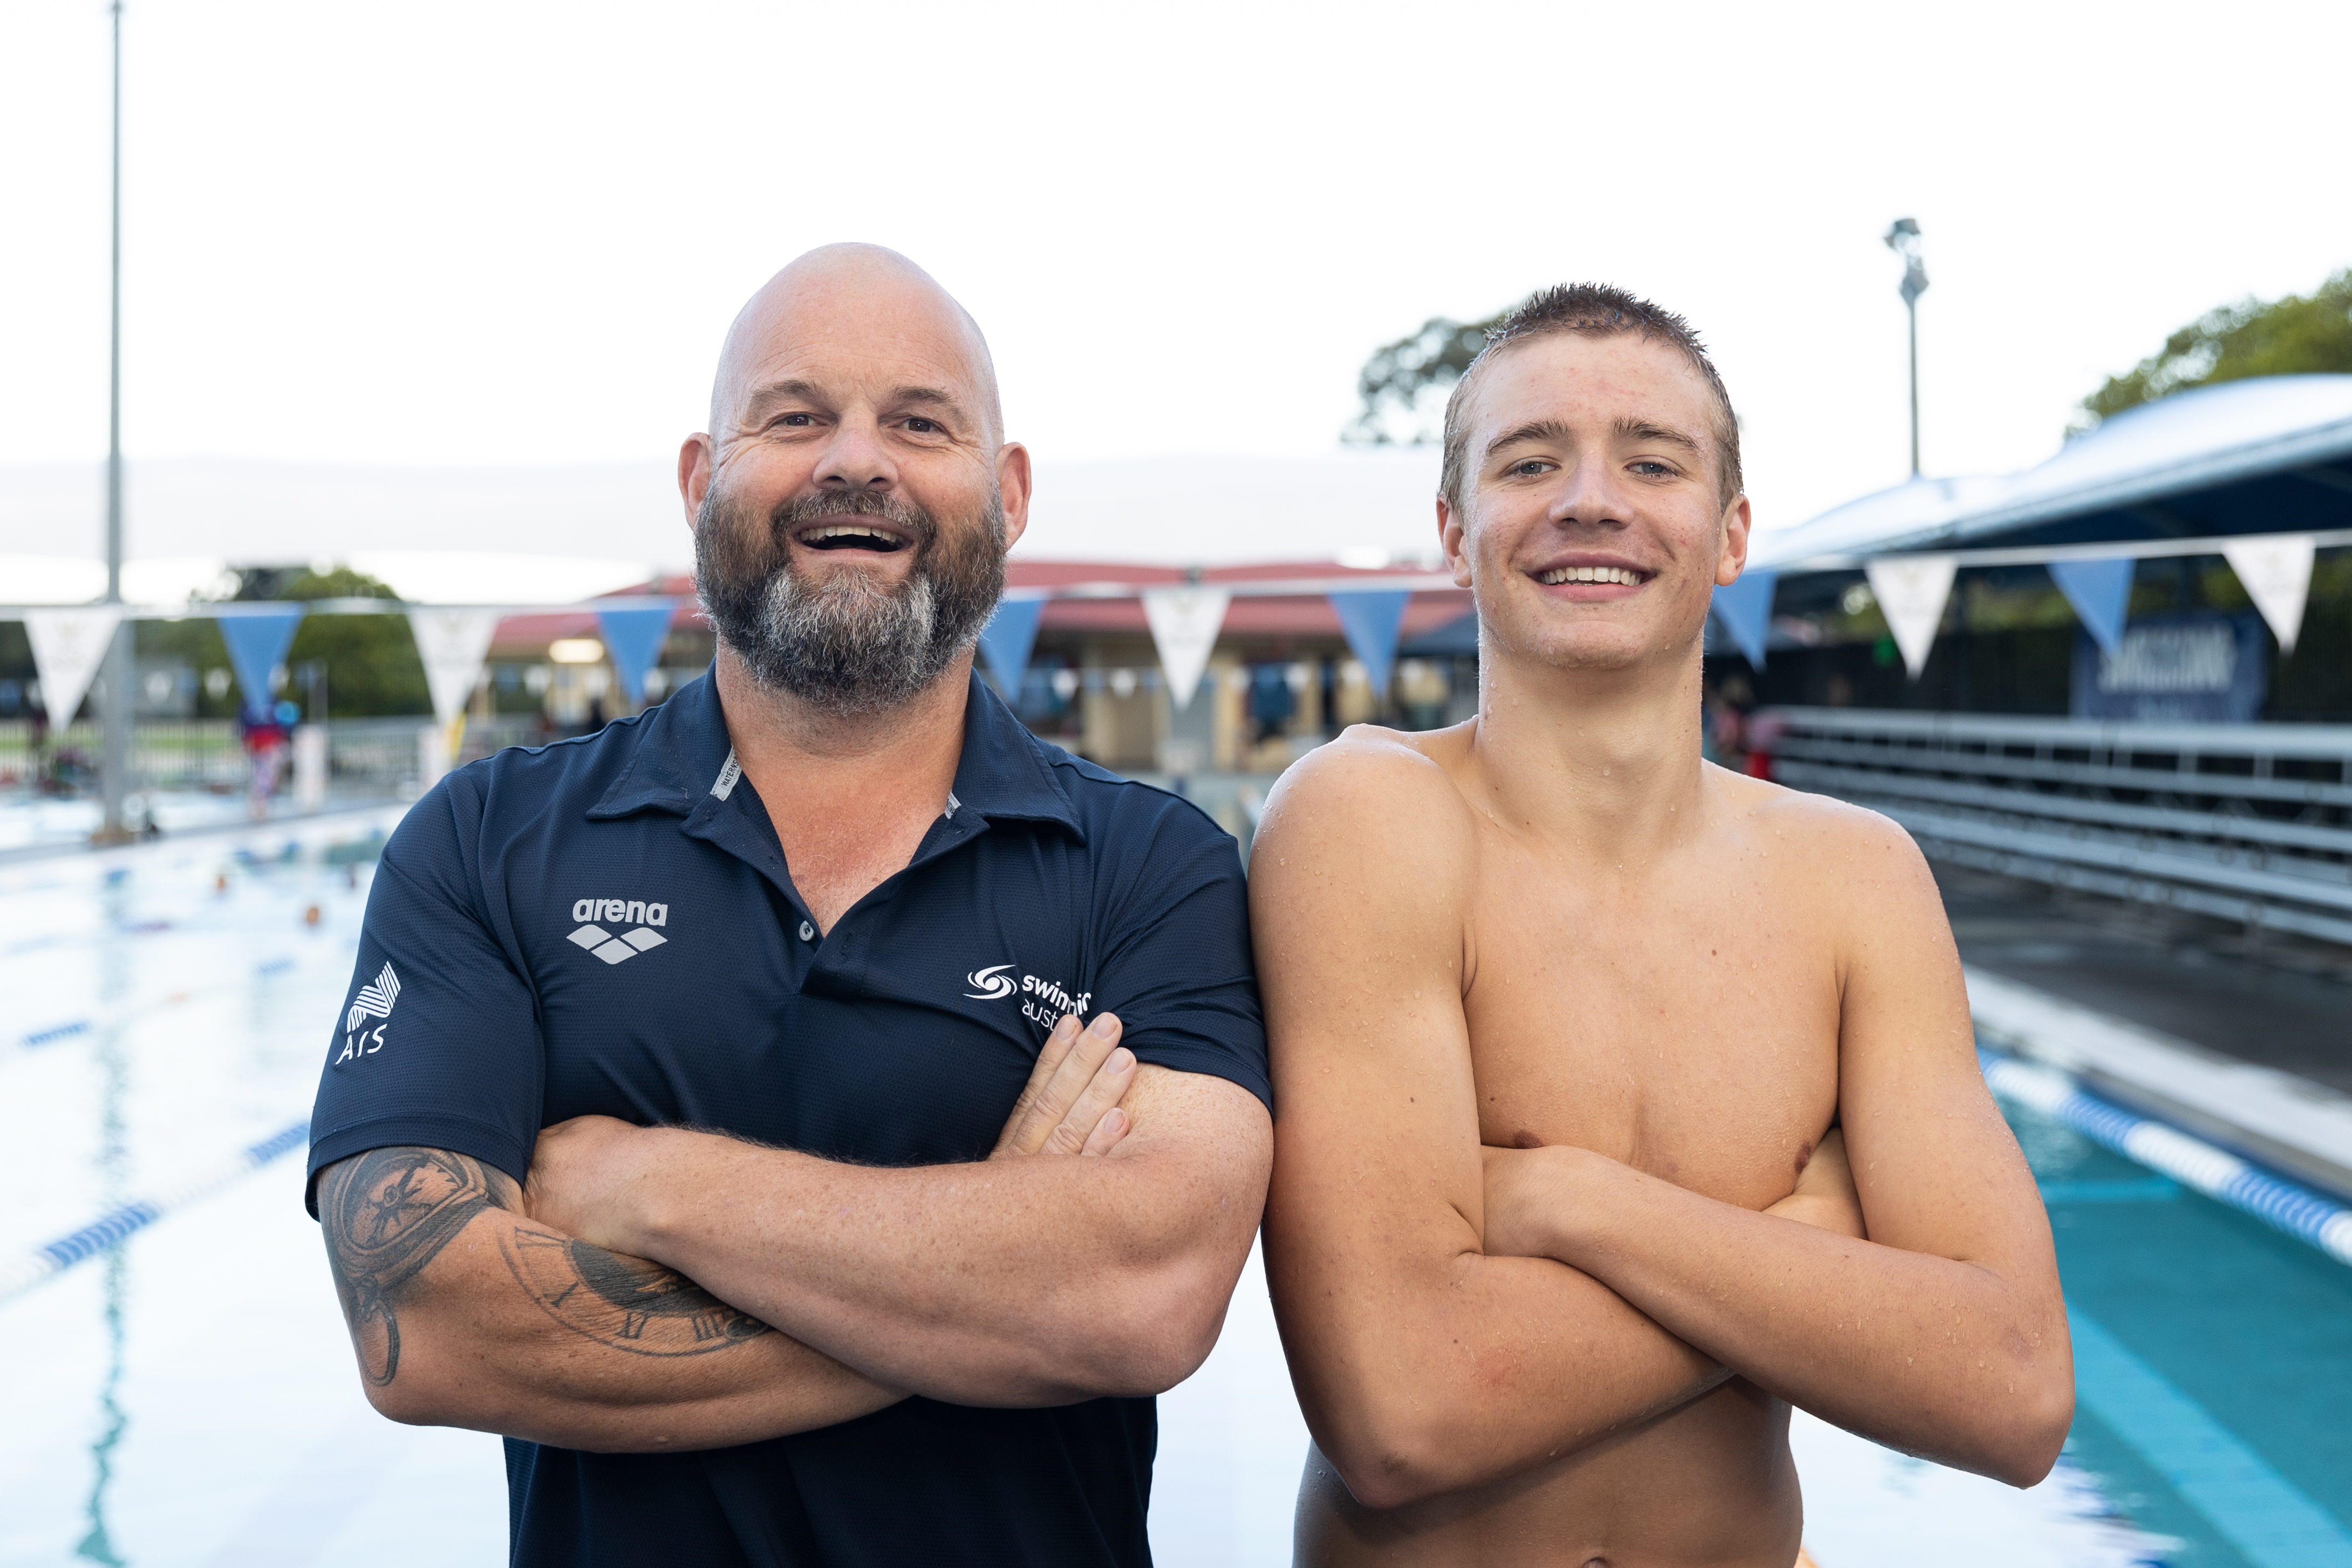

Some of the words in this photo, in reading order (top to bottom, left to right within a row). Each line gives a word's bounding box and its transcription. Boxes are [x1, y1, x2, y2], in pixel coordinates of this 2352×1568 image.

[572, 898, 669, 926] arena
[1022, 998, 1058, 1032] aust
[335, 1023, 387, 1065] AIS
